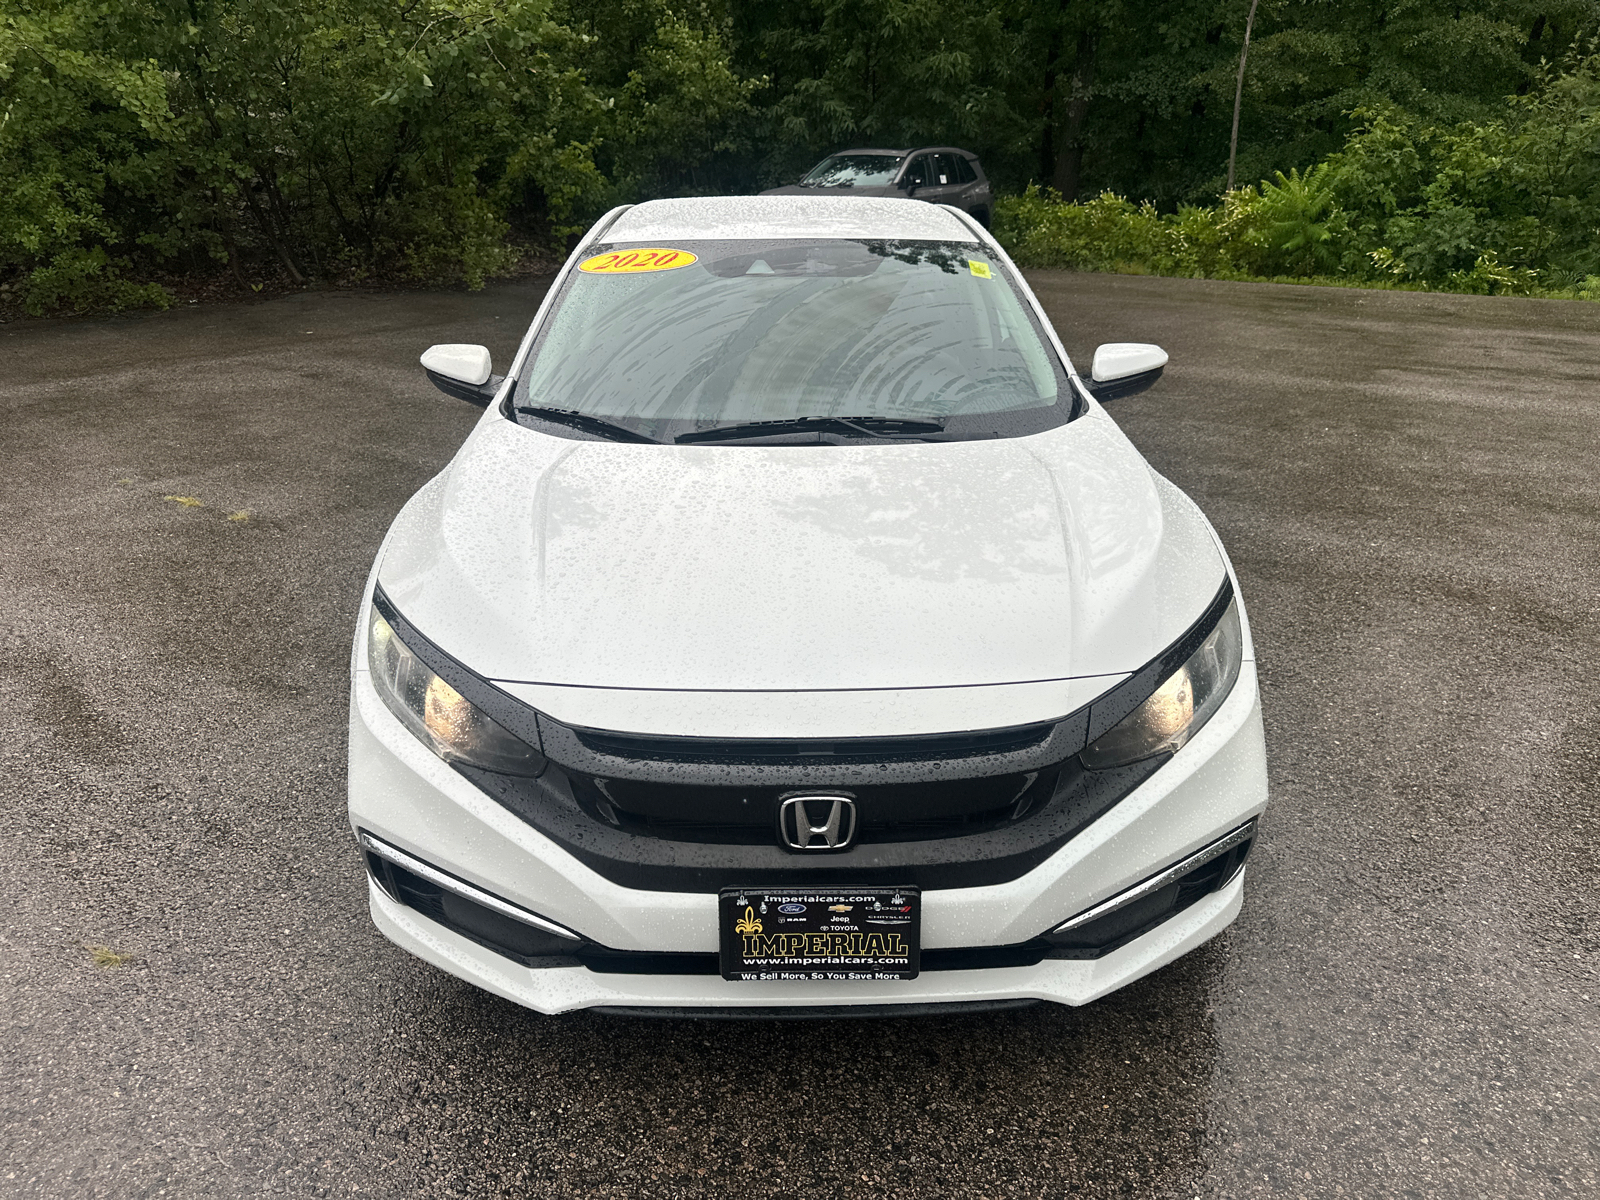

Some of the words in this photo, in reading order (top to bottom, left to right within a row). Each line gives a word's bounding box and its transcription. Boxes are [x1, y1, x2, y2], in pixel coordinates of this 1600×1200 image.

[592, 252, 679, 270] 2020
[764, 895, 876, 903] Imperialcars.com
[743, 933, 908, 957] IMPERIAL
[743, 956, 908, 965] www.imperialcars.com
